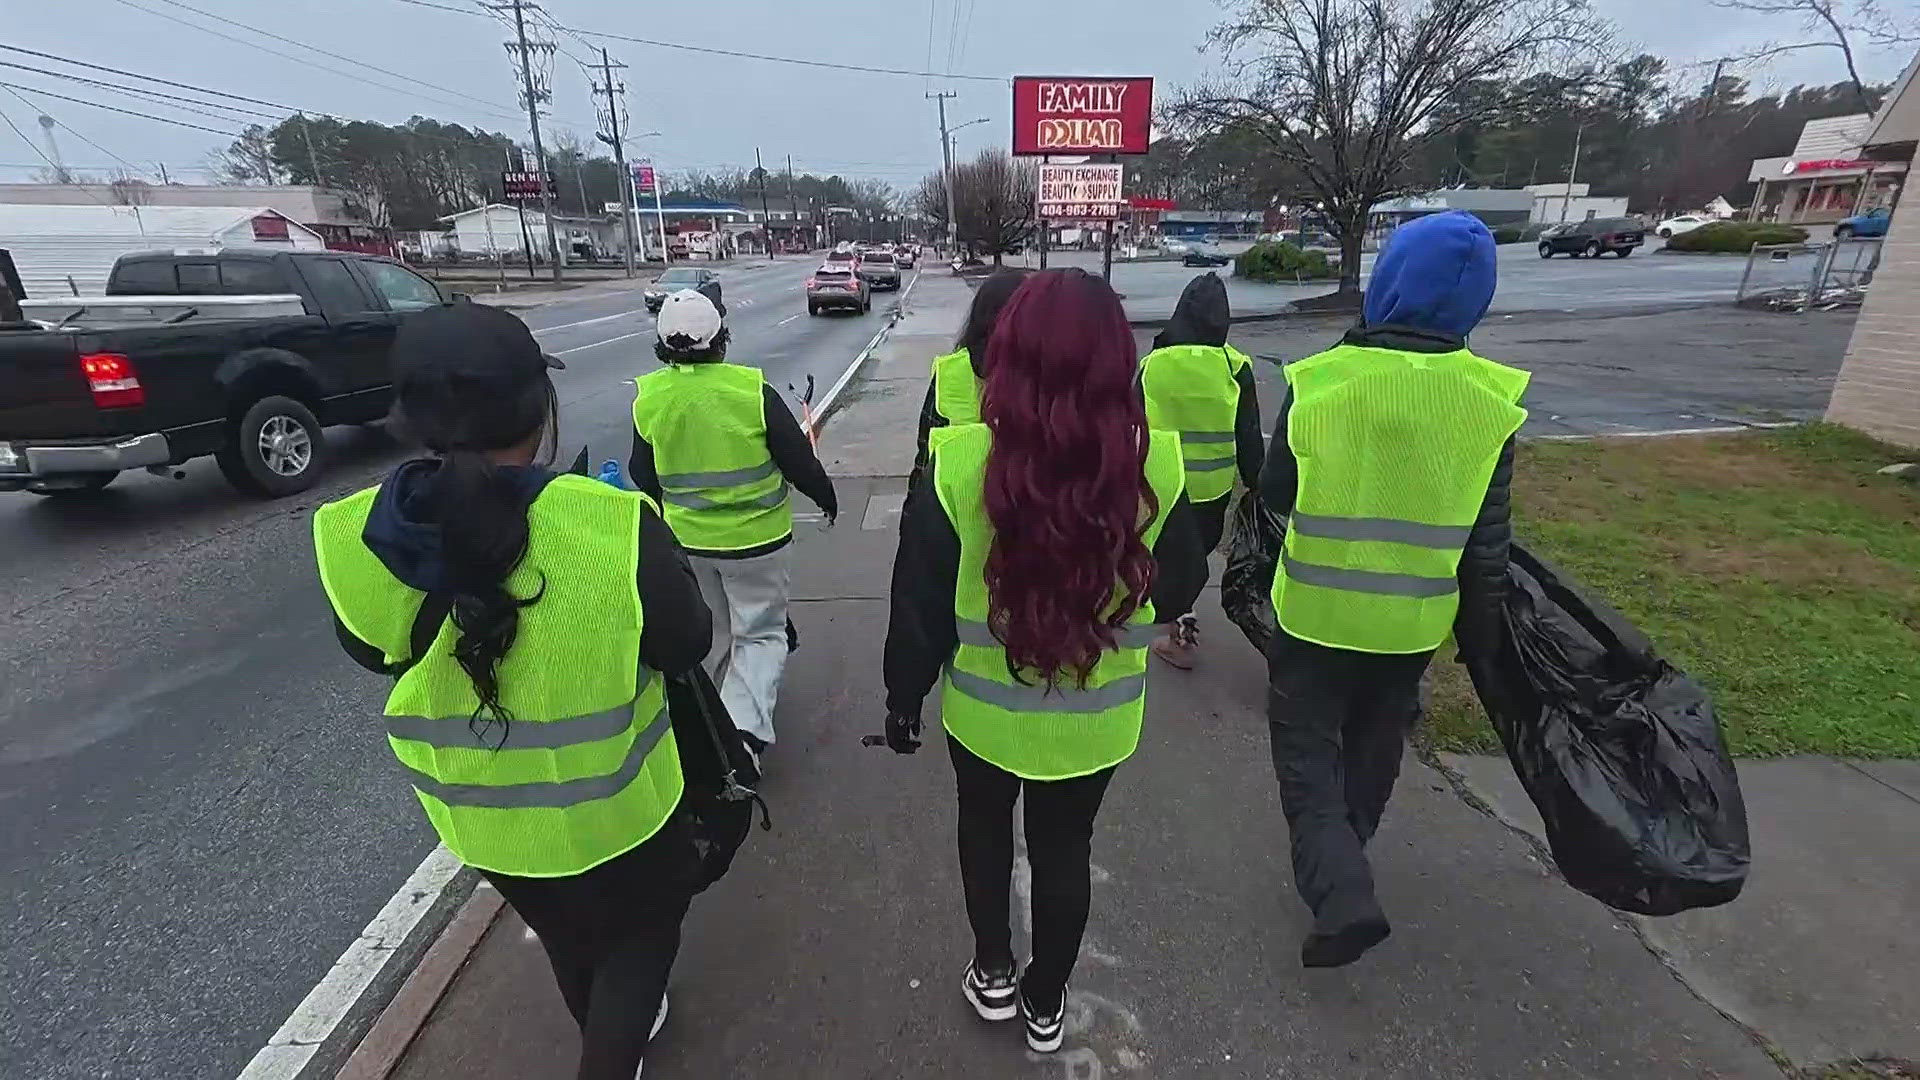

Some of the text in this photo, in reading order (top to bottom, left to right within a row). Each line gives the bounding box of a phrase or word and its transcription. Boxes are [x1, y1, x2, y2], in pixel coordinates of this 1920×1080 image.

[1038, 83, 1127, 113] FAMILY
[1038, 119, 1123, 148] DOLLAR
[528, 172, 552, 182] HIL
[1042, 168, 1119, 182] BEAUTY EXCHANGE
[1041, 183, 1118, 200] BEAUTY SUPPLY
